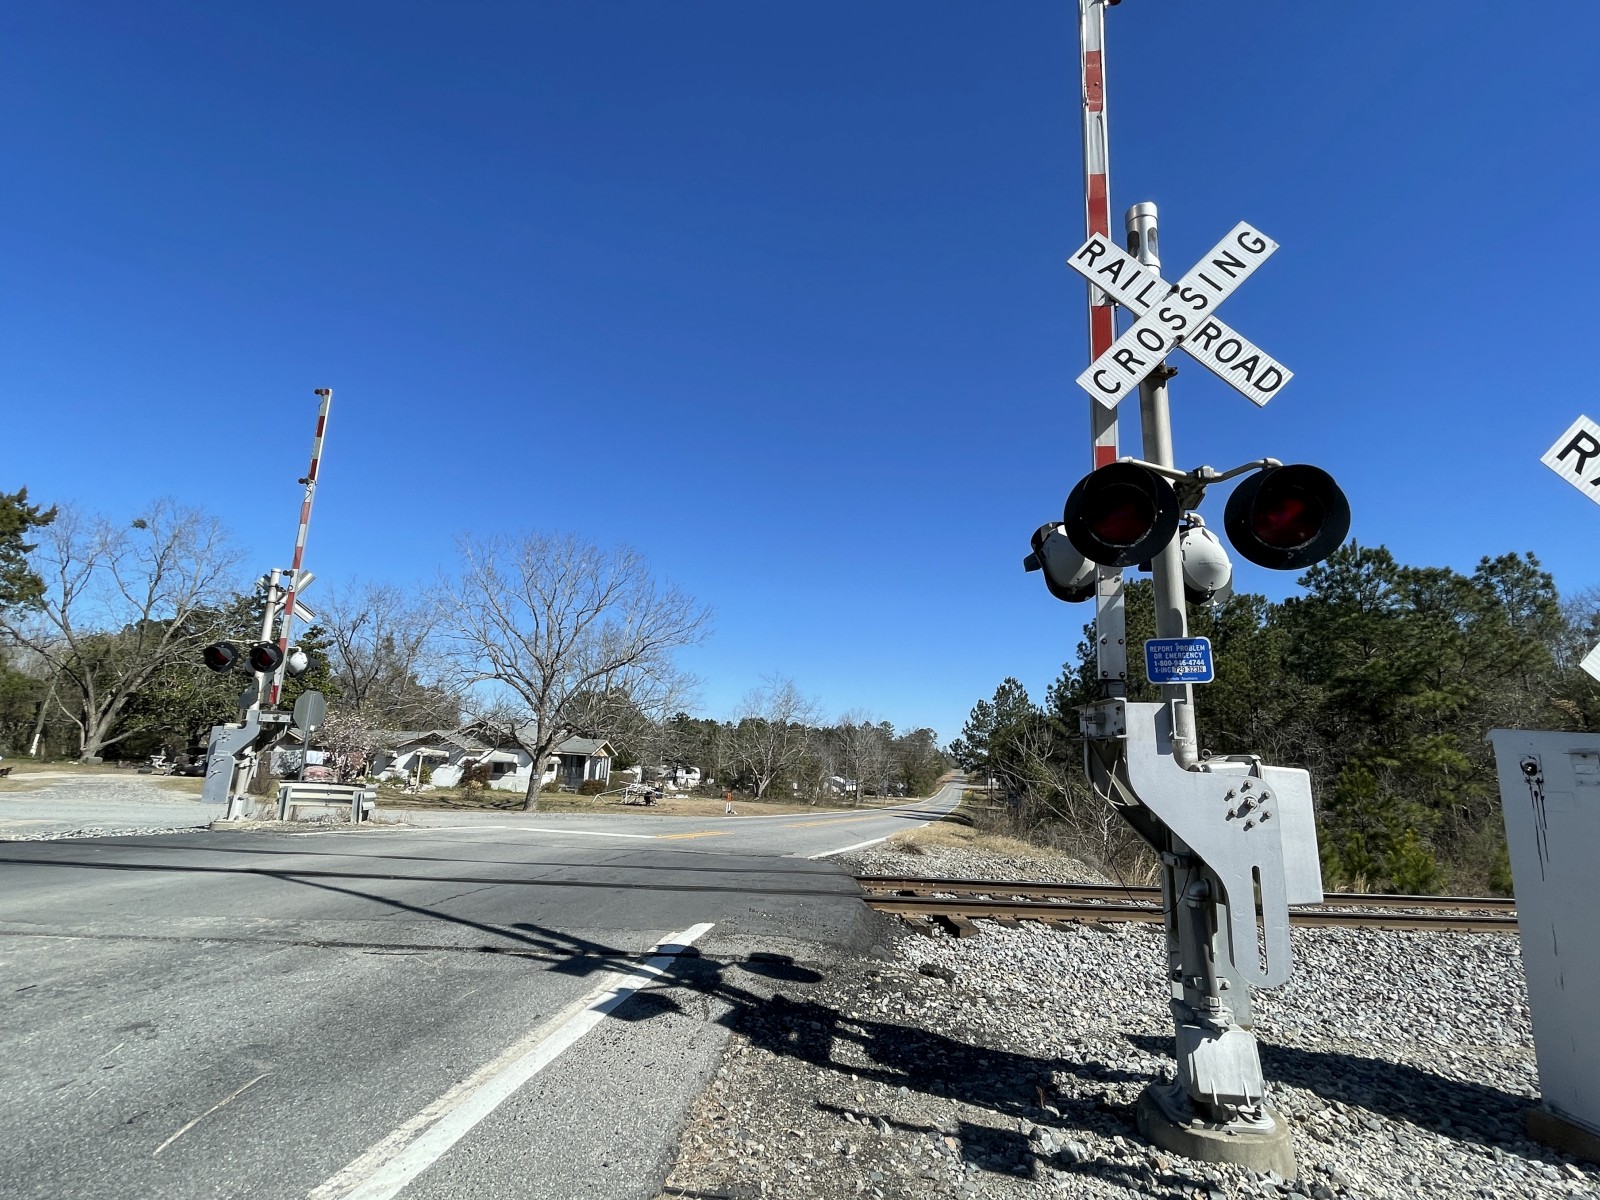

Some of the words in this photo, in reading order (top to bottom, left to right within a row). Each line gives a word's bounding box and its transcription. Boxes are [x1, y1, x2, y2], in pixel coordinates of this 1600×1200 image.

[1077, 239, 1156, 308] RAIL
[1192, 321, 1283, 393] ROAD
[1093, 231, 1266, 394] CROSSING
[1556, 429, 1600, 487] R
